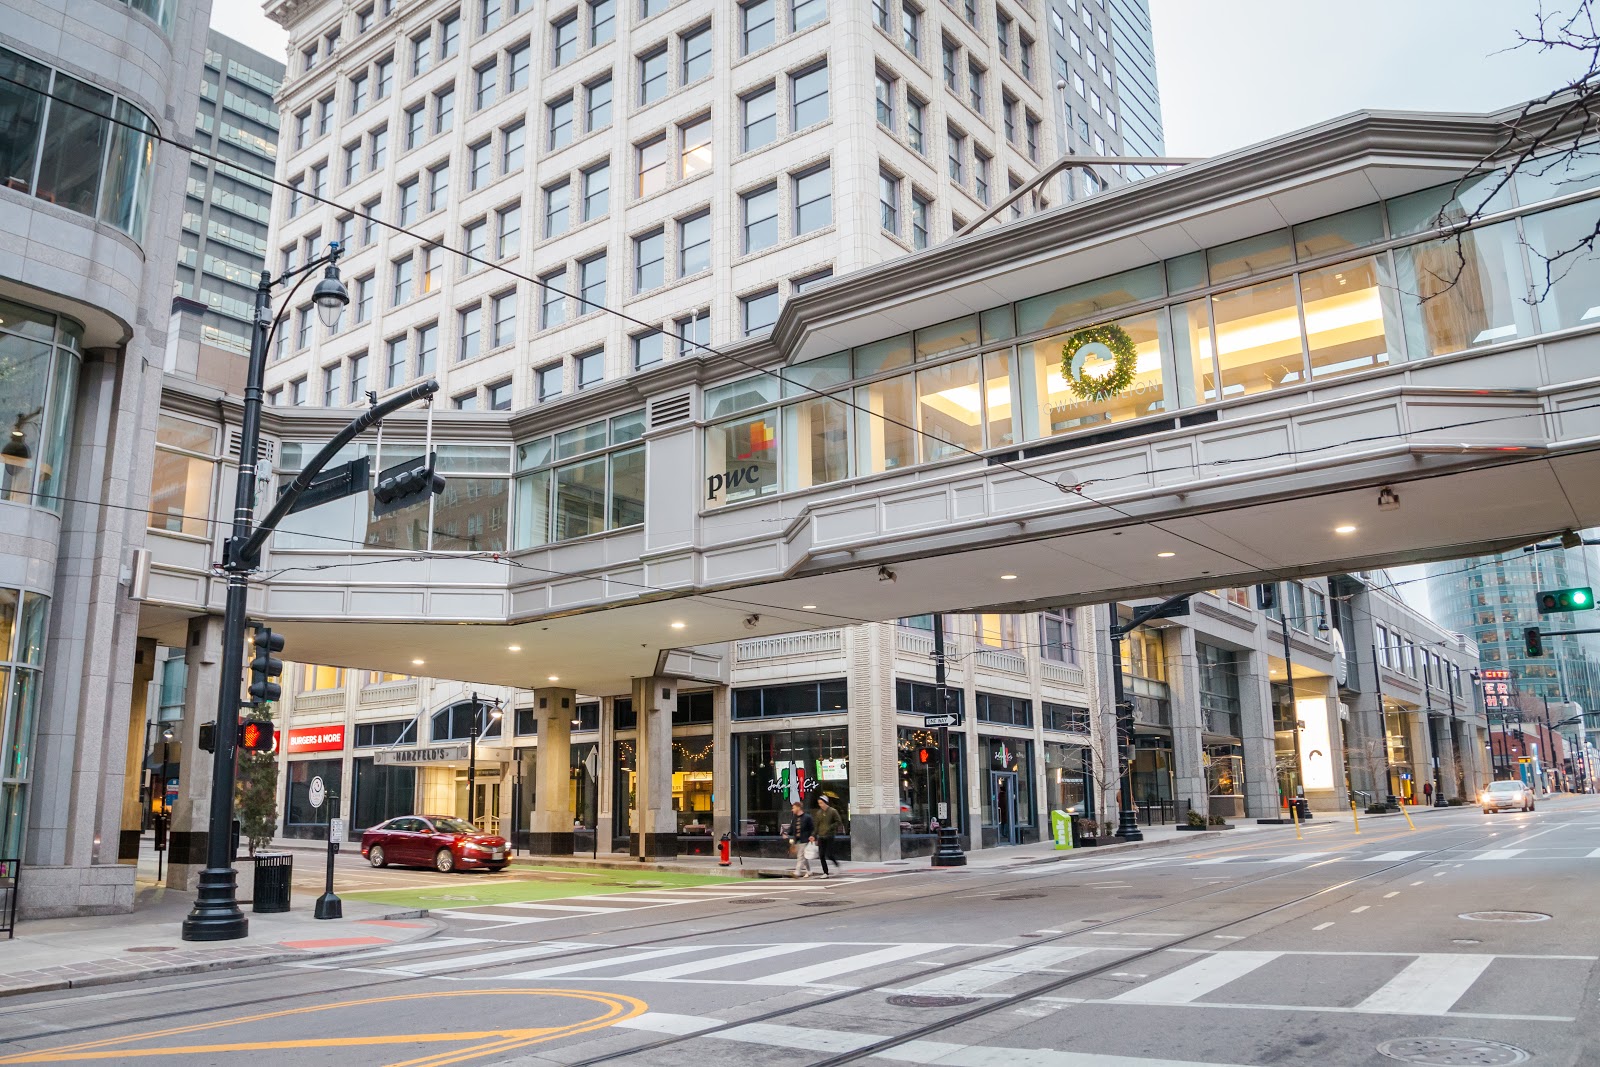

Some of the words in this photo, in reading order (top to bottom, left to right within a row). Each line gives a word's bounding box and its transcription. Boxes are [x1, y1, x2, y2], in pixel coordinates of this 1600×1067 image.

[1034, 397, 1079, 416] OWN
[1086, 378, 1159, 407] PAVILION
[707, 465, 760, 501] pwc
[290, 735, 318, 745] BURGERS
[317, 735, 323, 743] &
[323, 733, 341, 743] MORE
[396, 749, 445, 762] HARZFELD'S
[804, 777, 819, 789] C's
